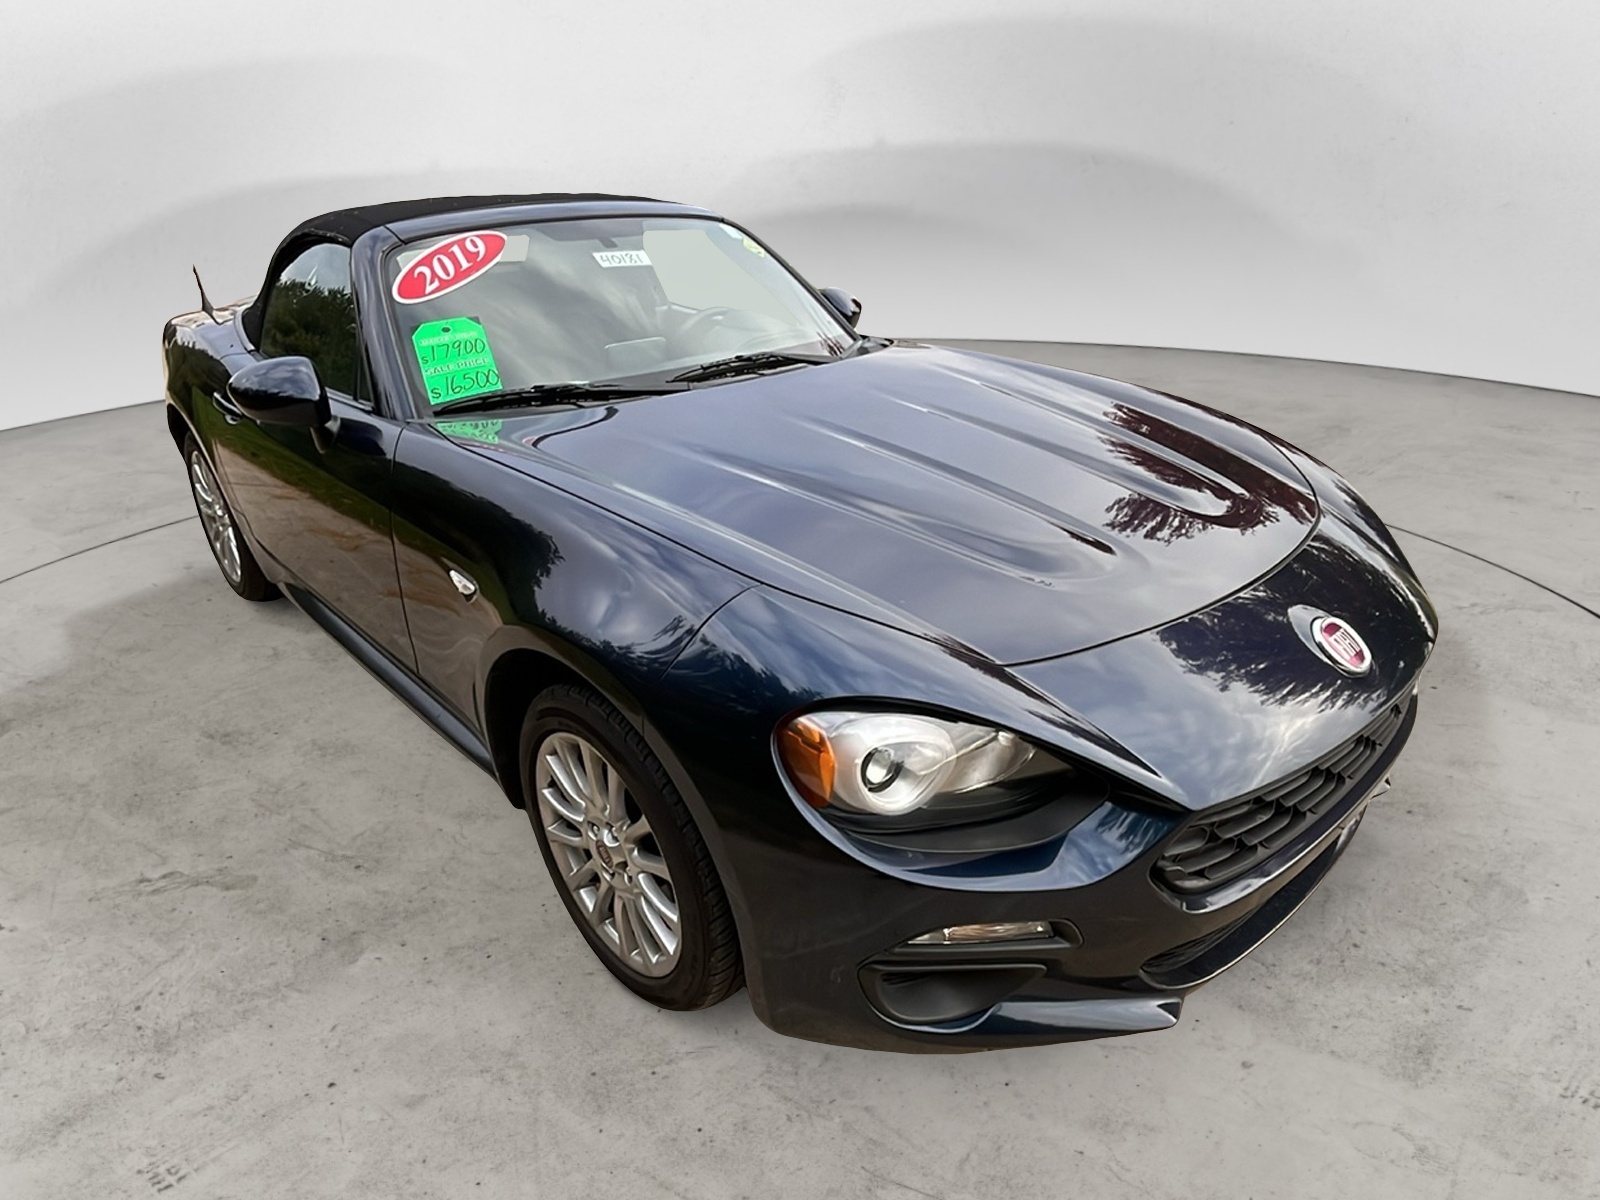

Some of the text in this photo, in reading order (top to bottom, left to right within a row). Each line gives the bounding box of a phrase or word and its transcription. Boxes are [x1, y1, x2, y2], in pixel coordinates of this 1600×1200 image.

[414, 235, 487, 295] 2019
[600, 253, 643, 265] 40181
[425, 357, 489, 376] SALE PRICE
